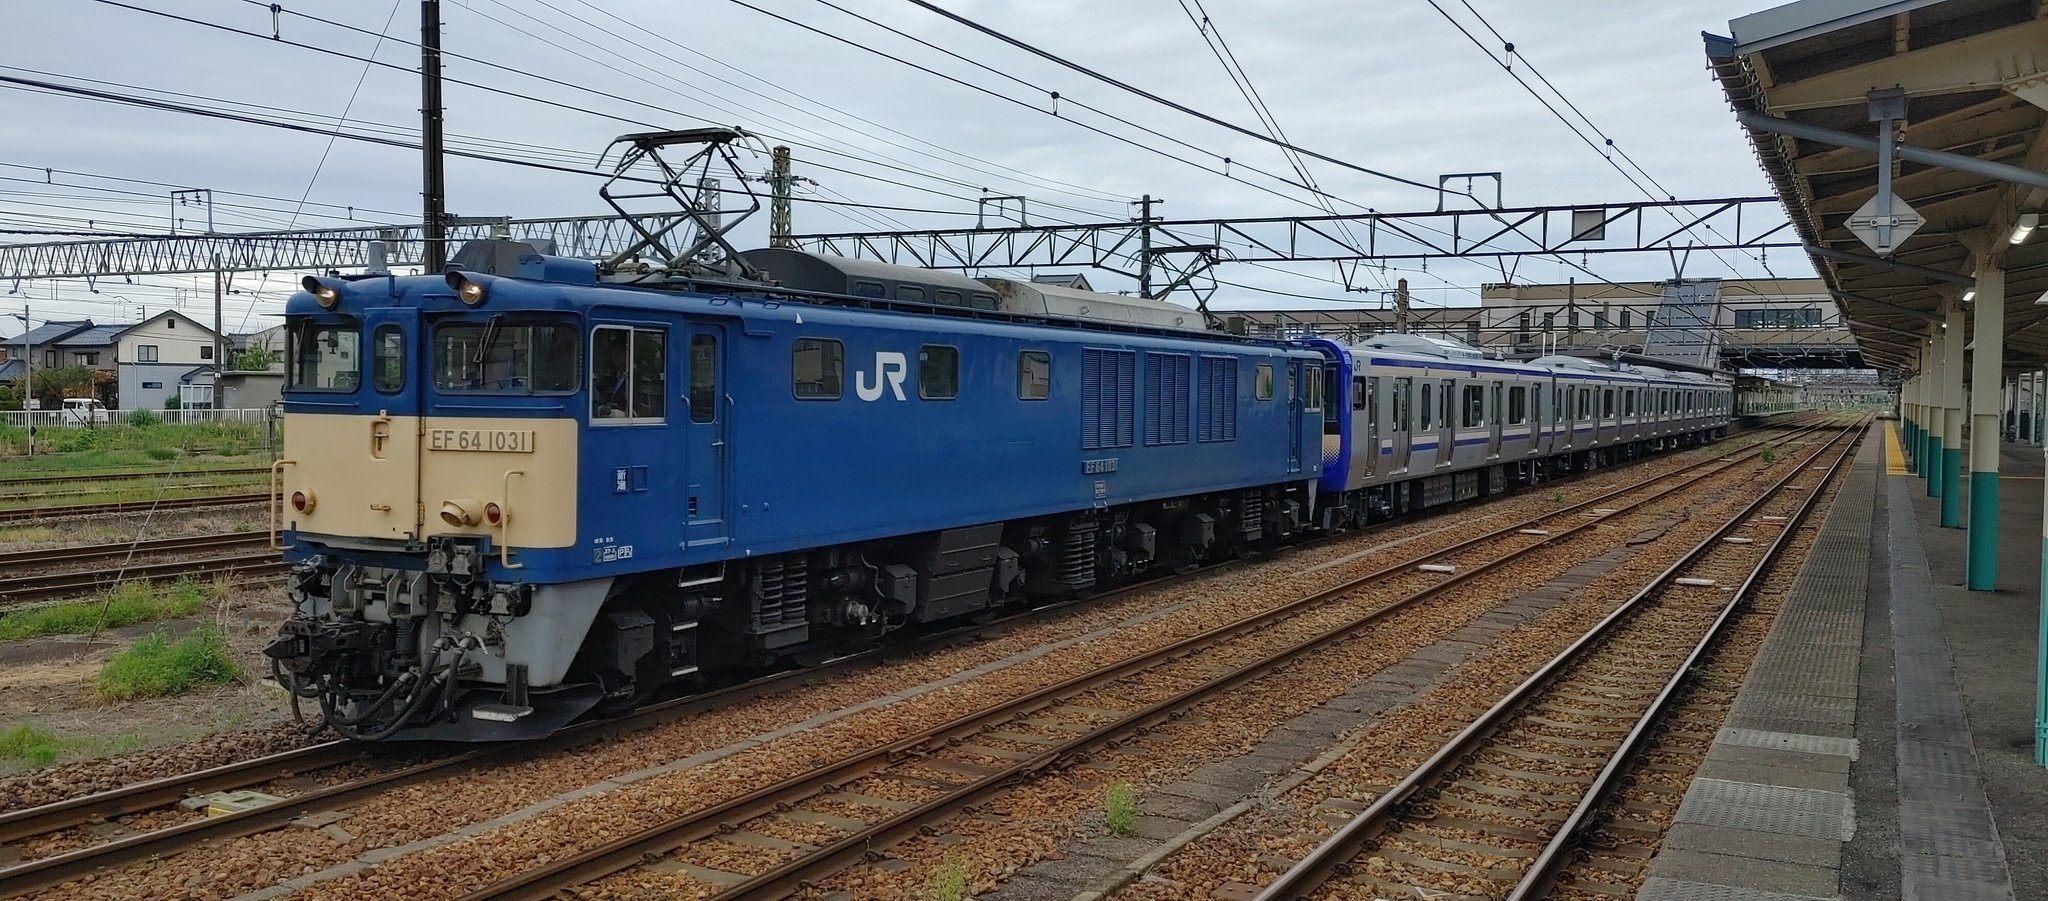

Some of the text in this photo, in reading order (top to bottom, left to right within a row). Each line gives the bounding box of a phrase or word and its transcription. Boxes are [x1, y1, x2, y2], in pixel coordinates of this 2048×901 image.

[1353, 359, 1362, 372] JR
[856, 351, 907, 402] JR
[432, 430, 526, 451] EF 64 1031
